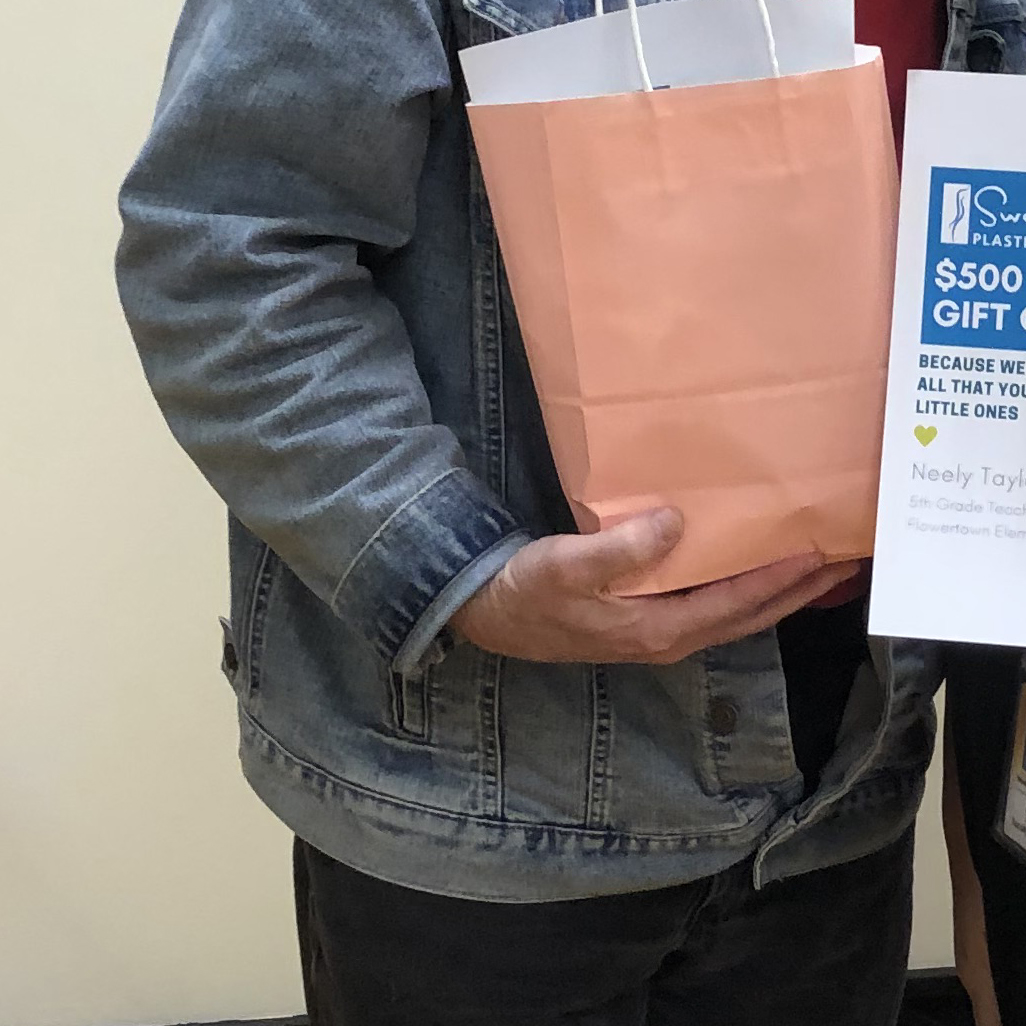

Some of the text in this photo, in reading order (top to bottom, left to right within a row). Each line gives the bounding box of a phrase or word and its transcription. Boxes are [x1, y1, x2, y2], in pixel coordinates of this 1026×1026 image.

[934, 257, 1023, 293] $500
[932, 299, 1012, 331] GIFT
[918, 354, 995, 373] BECAUSE
[1000, 360, 1026, 375] WE
[917, 376, 946, 392] ALL
[951, 379, 994, 396] THAT
[915, 400, 1019, 420] LITTLE ONES
[911, 462, 973, 489] Neely
[908, 495, 931, 508] 5th
[936, 497, 983, 513] Grade
